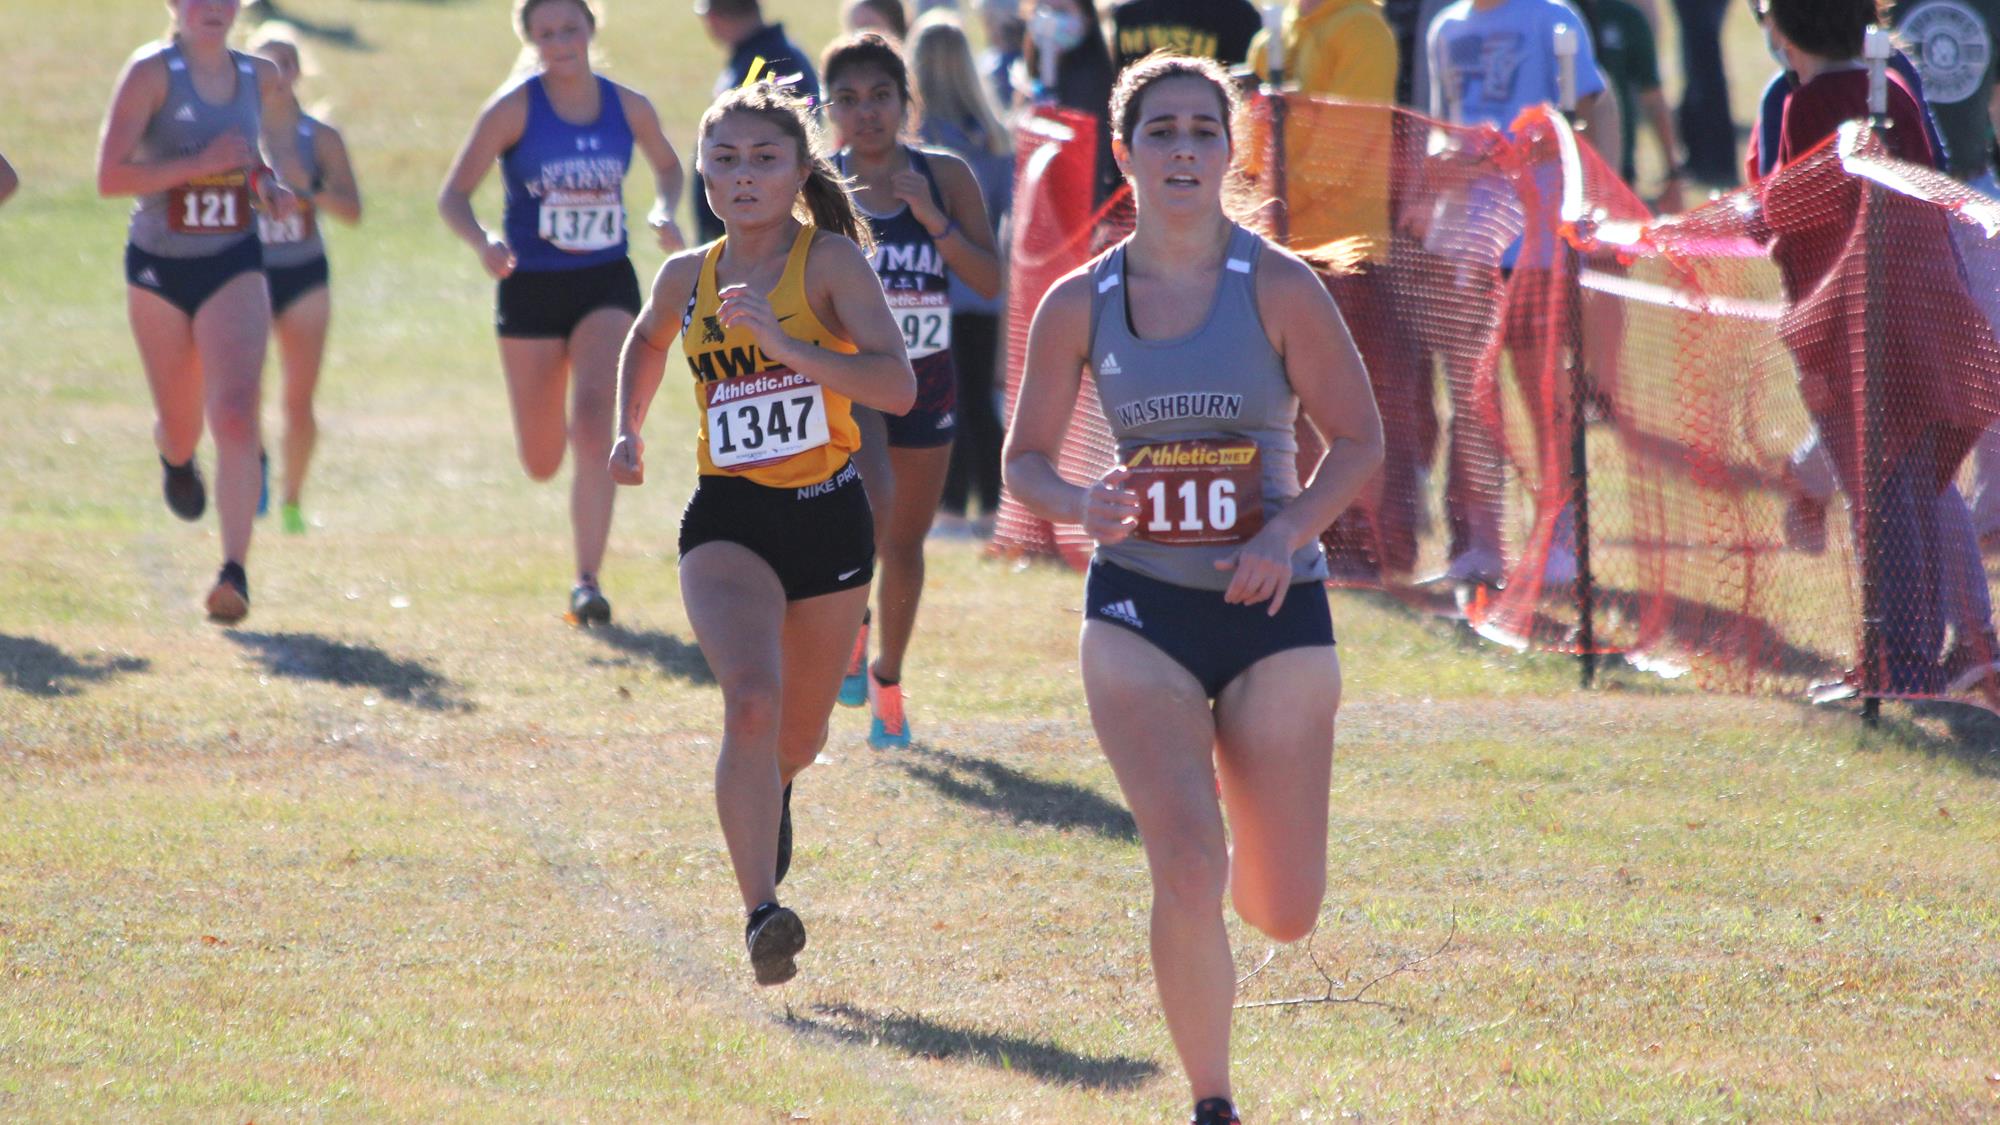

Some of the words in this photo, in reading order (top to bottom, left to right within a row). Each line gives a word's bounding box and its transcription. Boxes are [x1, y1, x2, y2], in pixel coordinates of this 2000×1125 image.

[182, 191, 238, 227] 121
[548, 210, 615, 240] 1374
[711, 373, 814, 404] Athletic.ne
[716, 395, 815, 454] 1347
[1116, 391, 1243, 430] WASHBURN
[797, 480, 835, 500] NIKE
[836, 463, 857, 488] PRO
[1146, 478, 1238, 532] 116
